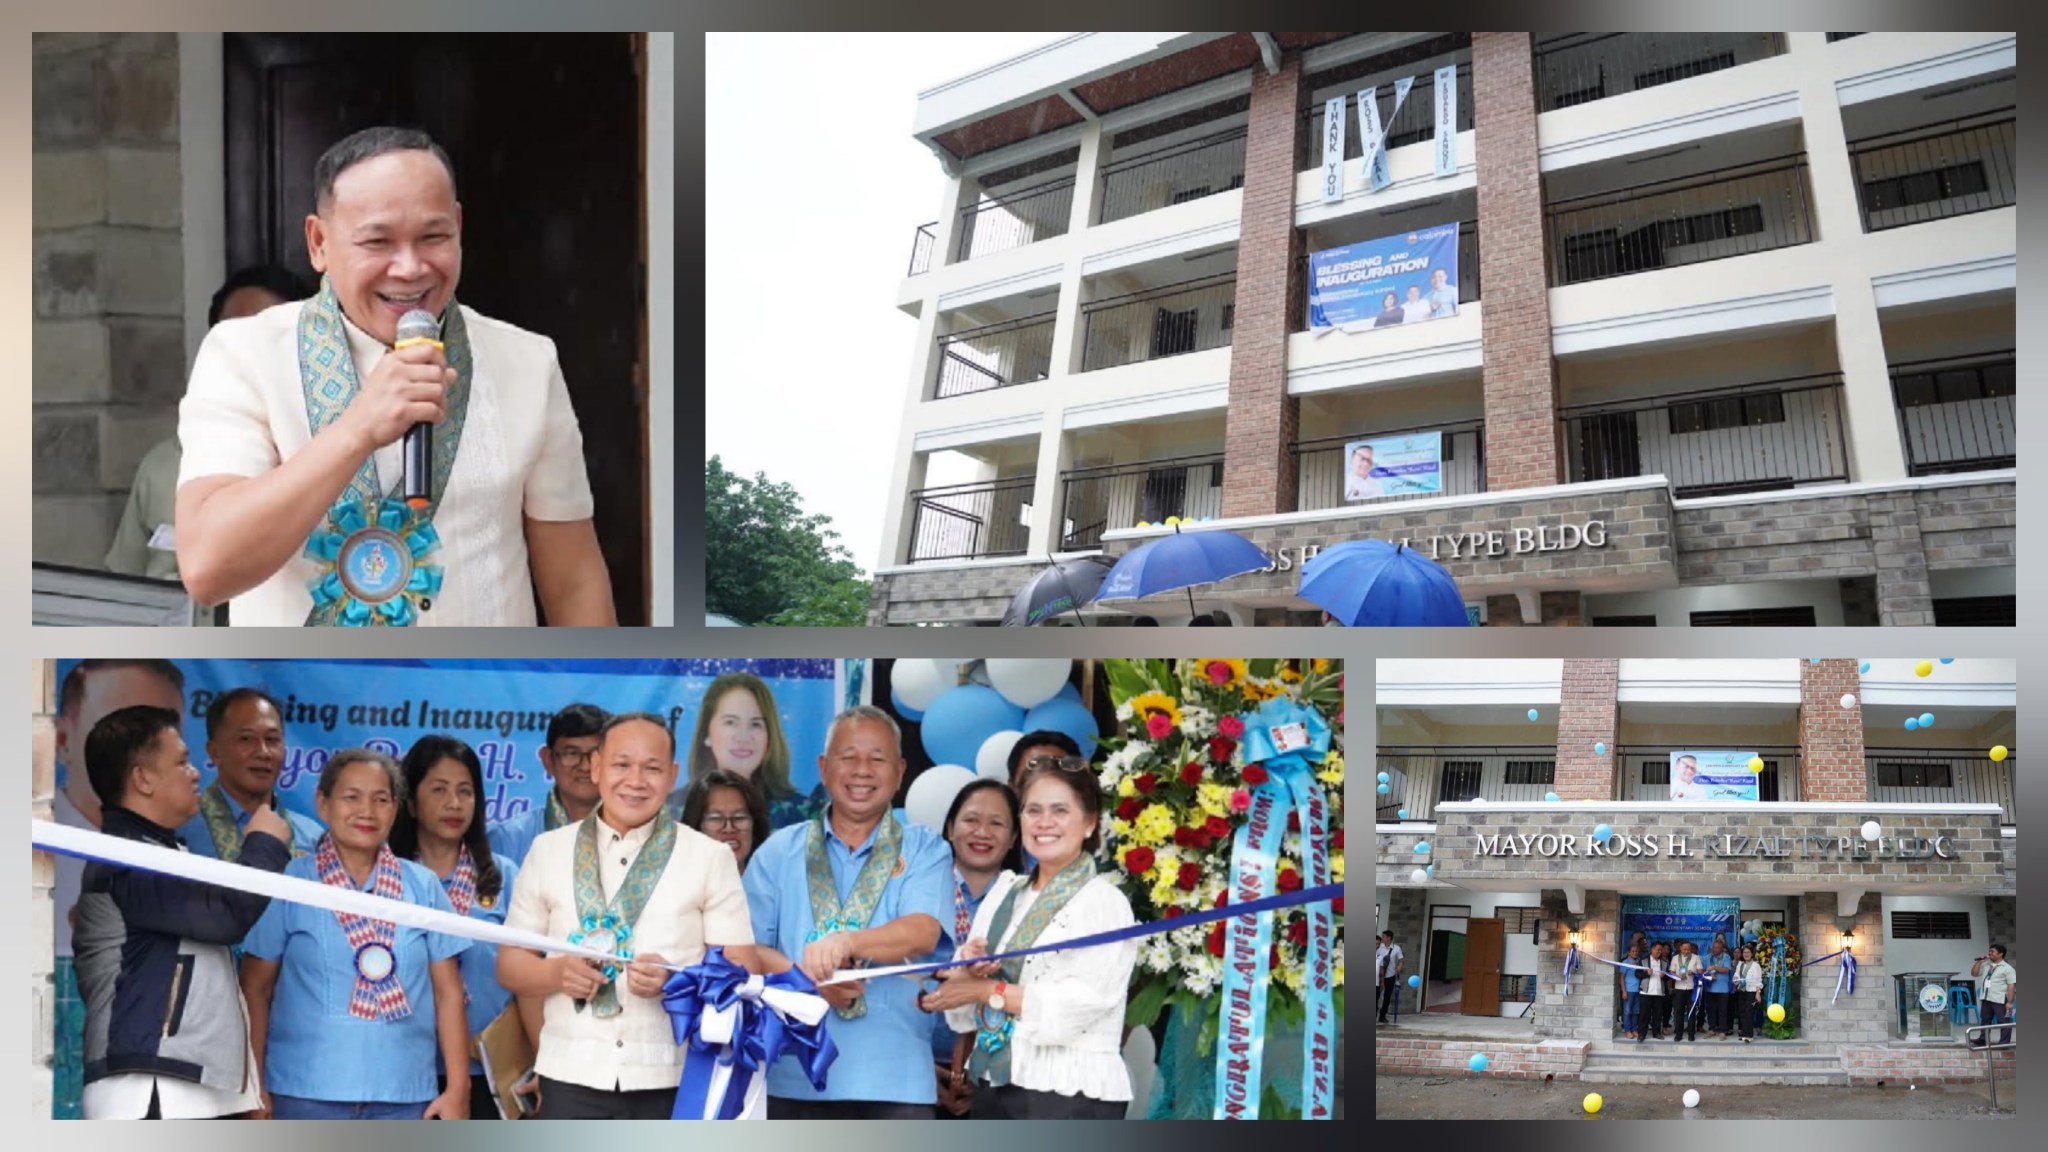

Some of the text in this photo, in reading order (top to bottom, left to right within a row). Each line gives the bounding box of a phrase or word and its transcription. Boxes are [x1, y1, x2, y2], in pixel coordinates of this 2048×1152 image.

[1327, 101, 1339, 197] THANK YOU
[1316, 251, 1410, 277] BLESSING AND
[1316, 256, 1430, 289] INAUGURATION
[1427, 530, 1507, 560] TYPE
[1514, 520, 1607, 554] BLDG
[189, 689, 340, 732] Bing
[347, 700, 411, 727] and
[478, 741, 525, 781] H.
[1474, 833, 1956, 859] MAYOR ROSS H. RIZAL TYPE BLDG
